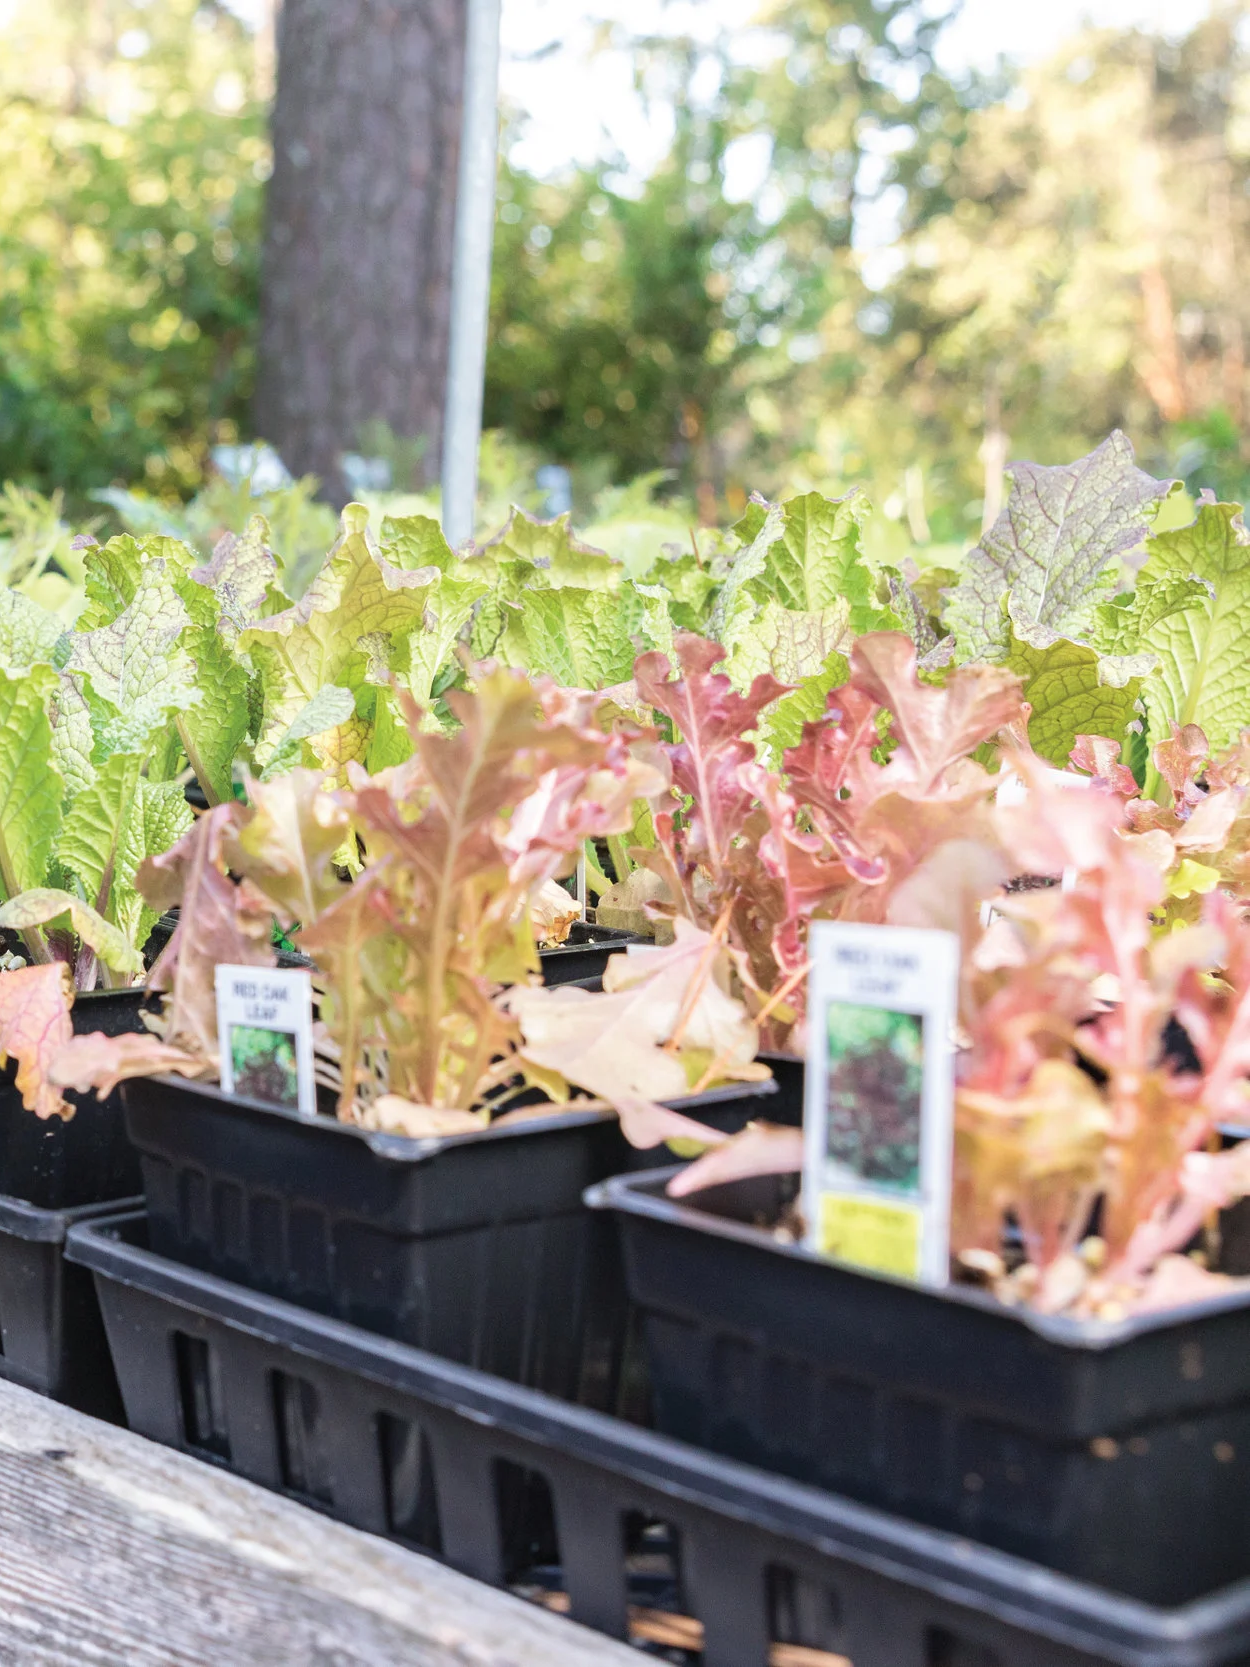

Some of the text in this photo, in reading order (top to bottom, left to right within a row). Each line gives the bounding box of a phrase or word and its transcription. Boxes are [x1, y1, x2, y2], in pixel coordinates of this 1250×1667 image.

[233, 981, 288, 1001] RED OAK
[246, 1003, 277, 1020] LEAF
